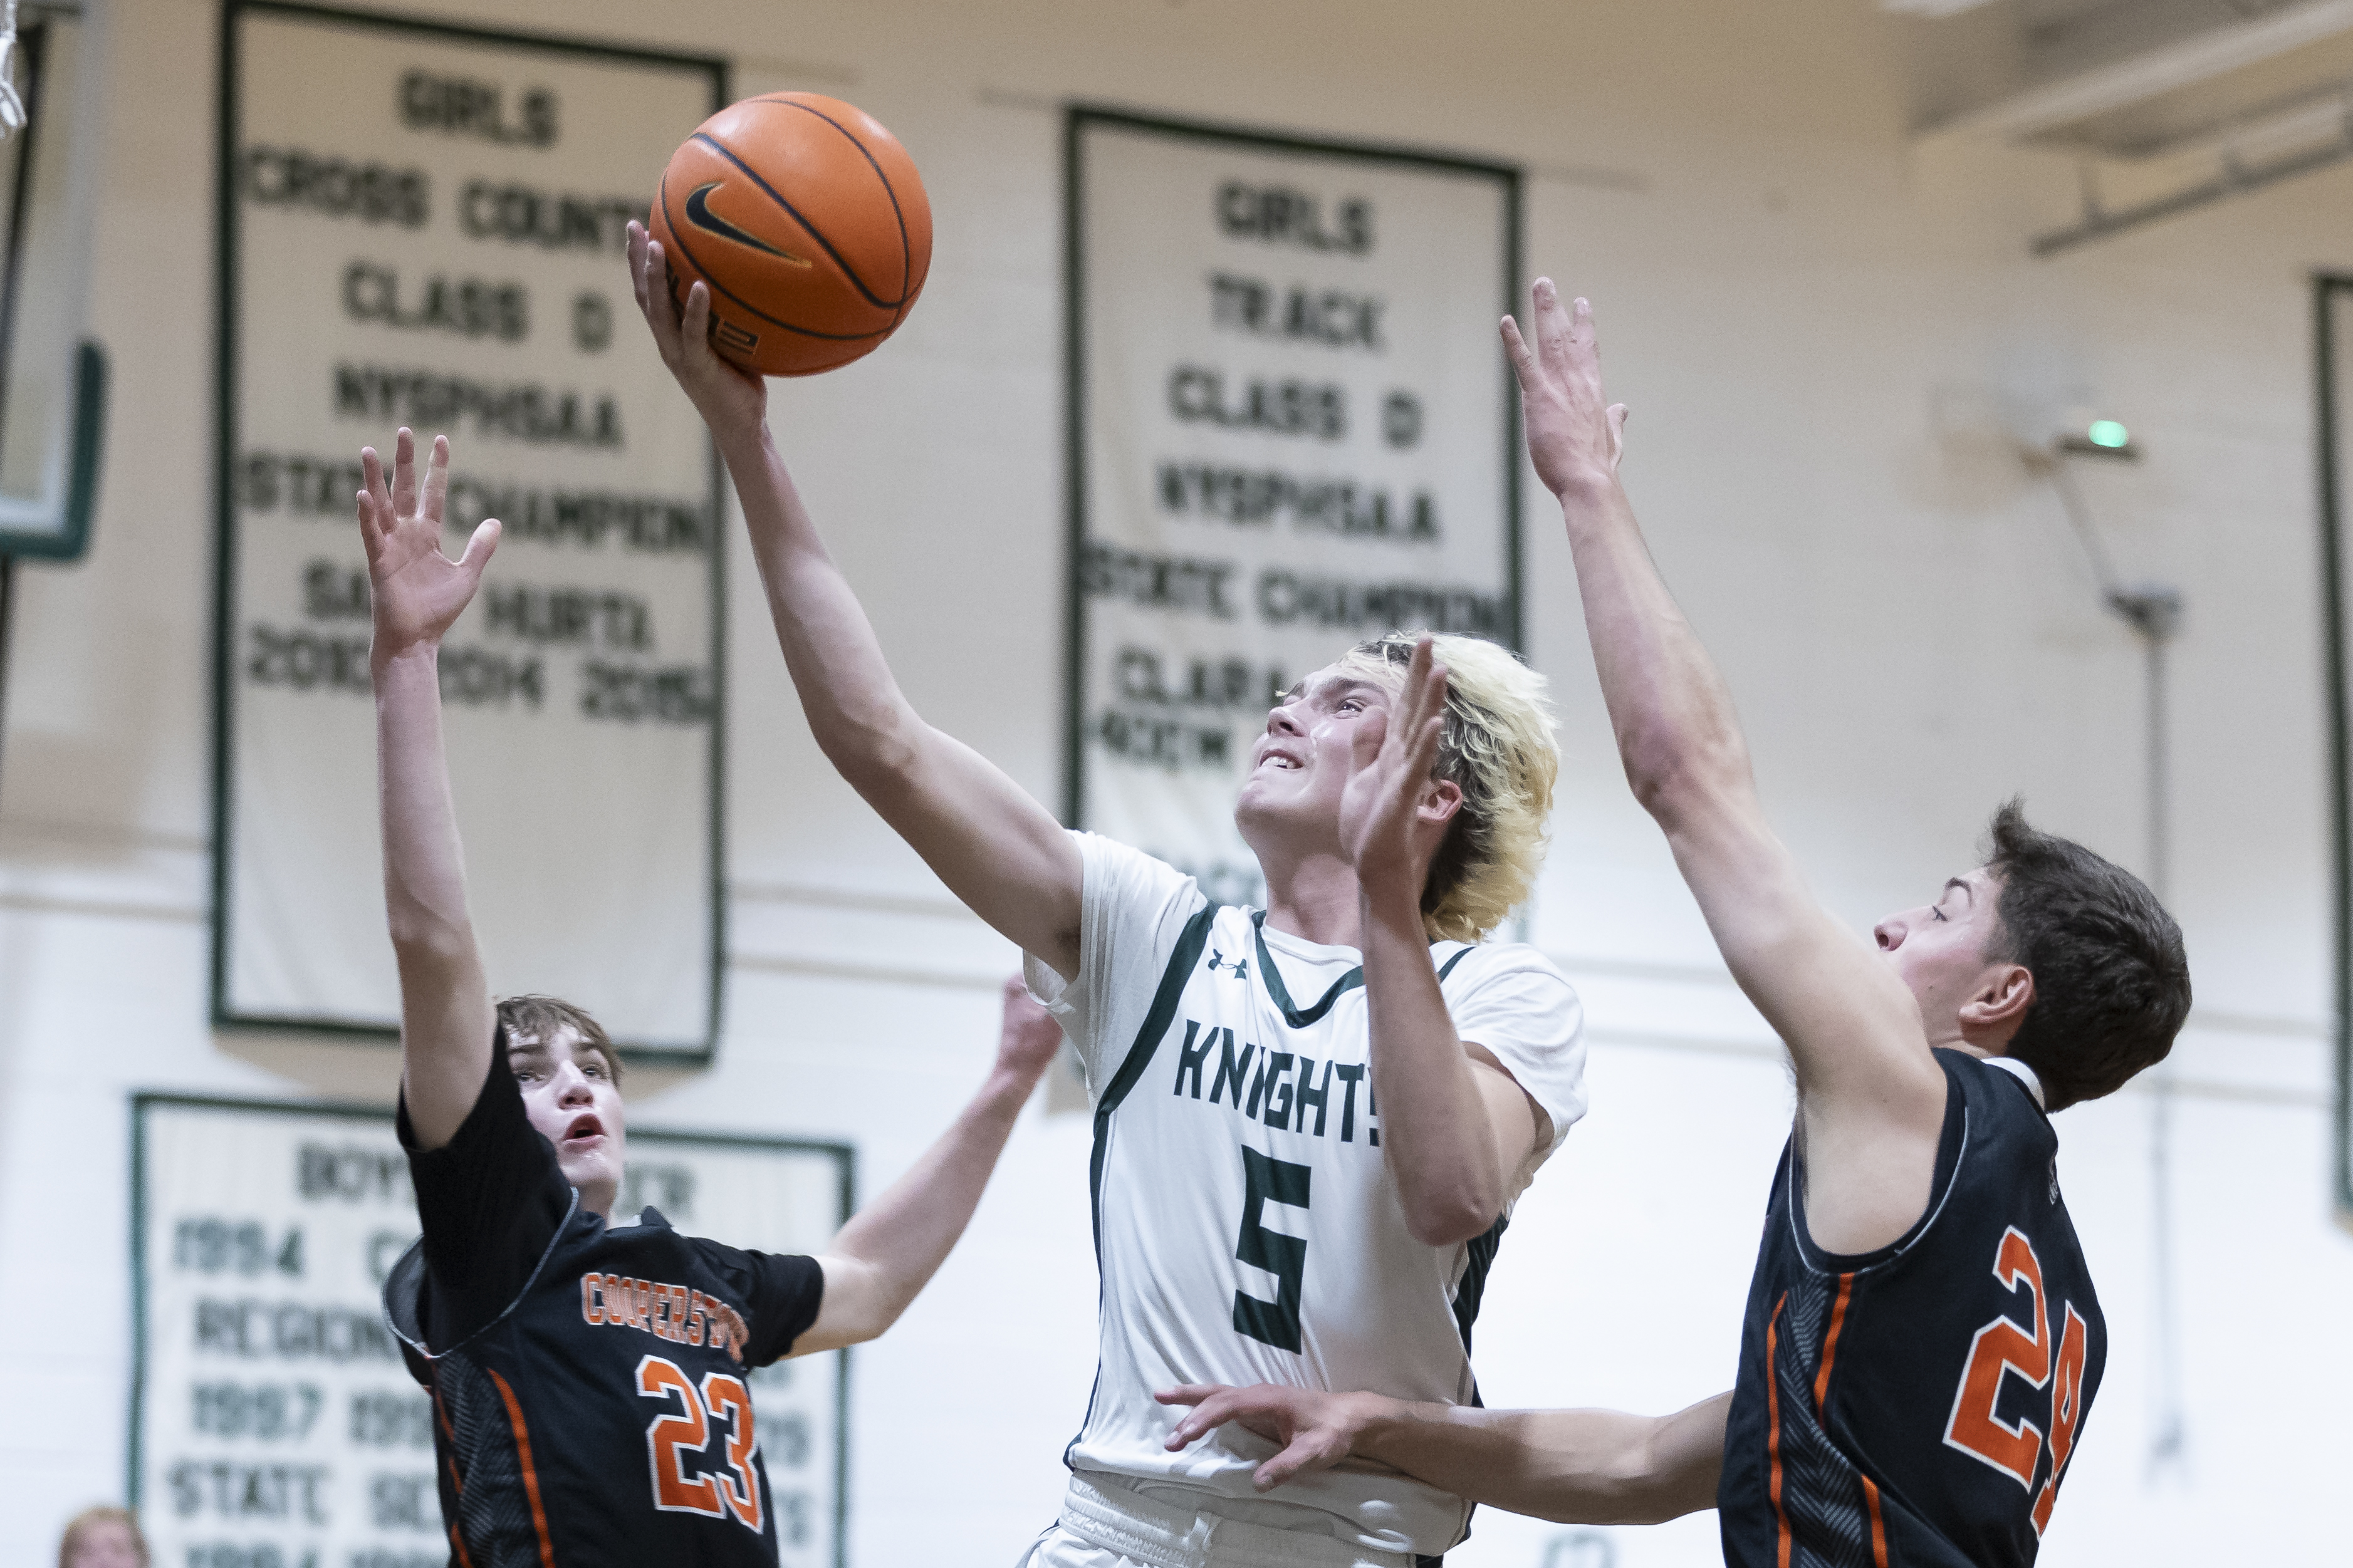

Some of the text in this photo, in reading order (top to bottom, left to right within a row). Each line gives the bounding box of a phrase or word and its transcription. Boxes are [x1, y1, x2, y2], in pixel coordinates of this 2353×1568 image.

[401, 70, 558, 147] GIRLS
[246, 146, 429, 227] CROSS
[1218, 182, 1372, 257] GIRLS
[342, 261, 528, 341] CLASS
[573, 289, 613, 351] D
[1211, 273, 1382, 351] TRACK
[1167, 365, 1423, 449] CLASS D
[1172, 1019, 1380, 1147] KNIGHT
[1233, 1144, 1312, 1356] 5
[1943, 1225, 2088, 1544] 24
[634, 1354, 765, 1536] 23
[165, 1464, 332, 1525] STATE
